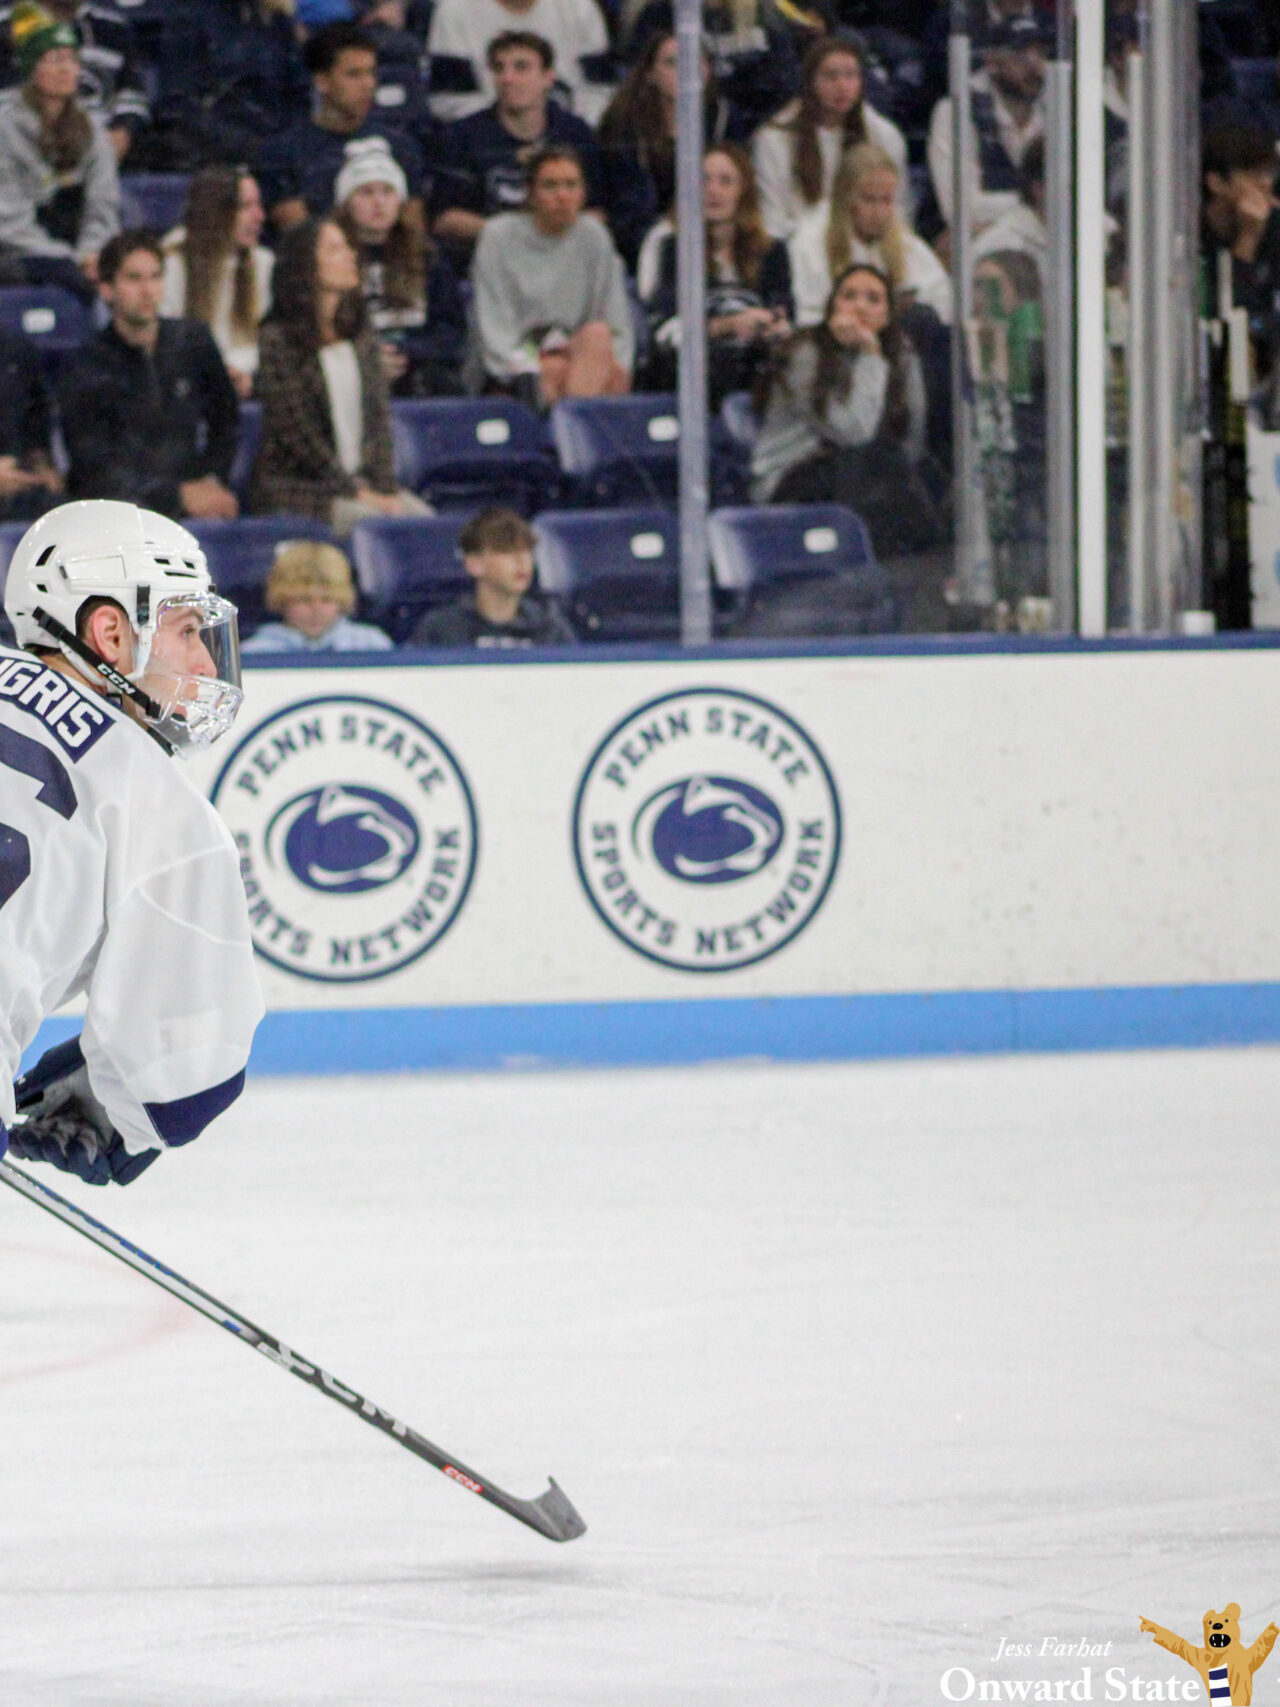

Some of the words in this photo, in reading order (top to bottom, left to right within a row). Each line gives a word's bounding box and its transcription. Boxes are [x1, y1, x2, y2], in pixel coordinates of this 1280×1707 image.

[97, 663, 136, 695] CCM
[236, 715, 324, 797] PENN
[340, 714, 446, 797] STATE
[603, 709, 690, 790] PENN
[705, 706, 811, 786] STATE
[329, 828, 461, 966] NETWORK
[592, 822, 678, 947] SPORTS
[695, 820, 824, 956] NETWORK
[443, 1465, 484, 1493] CCM
